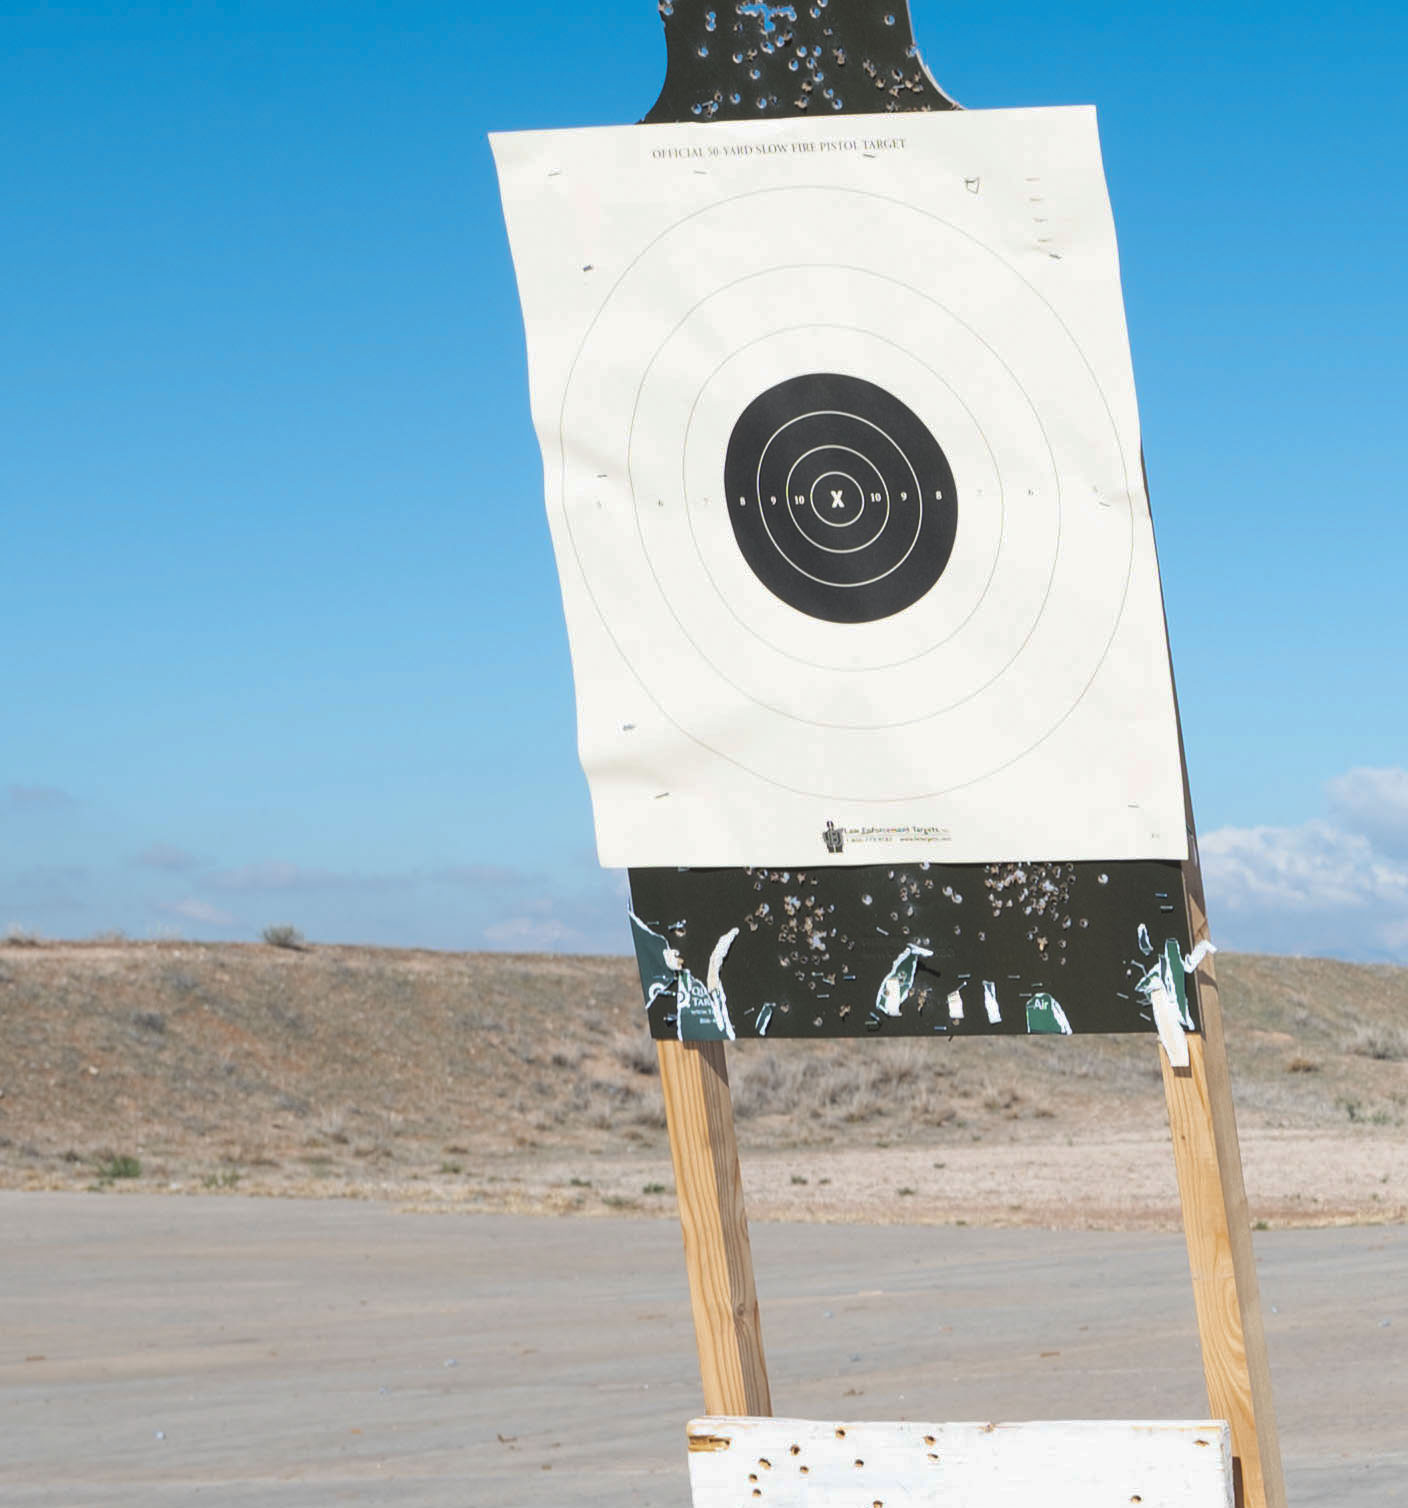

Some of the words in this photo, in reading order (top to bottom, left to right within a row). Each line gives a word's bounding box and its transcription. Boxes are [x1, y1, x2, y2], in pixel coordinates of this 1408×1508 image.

[652, 147, 703, 159] OFFICIAL
[755, 141, 789, 155] SLOW
[791, 140, 816, 153] FIRE
[819, 138, 858, 152] PISTOL
[862, 136, 906, 151] TARGET
[739, 496, 746, 506] 8
[770, 495, 777, 505] 9
[794, 495, 805, 505] 10
[830, 490, 845, 509] X
[871, 493, 881, 503] 10
[900, 491, 908, 501] 9
[935, 491, 942, 500] 8
[1033, 998, 1049, 1010] Air
